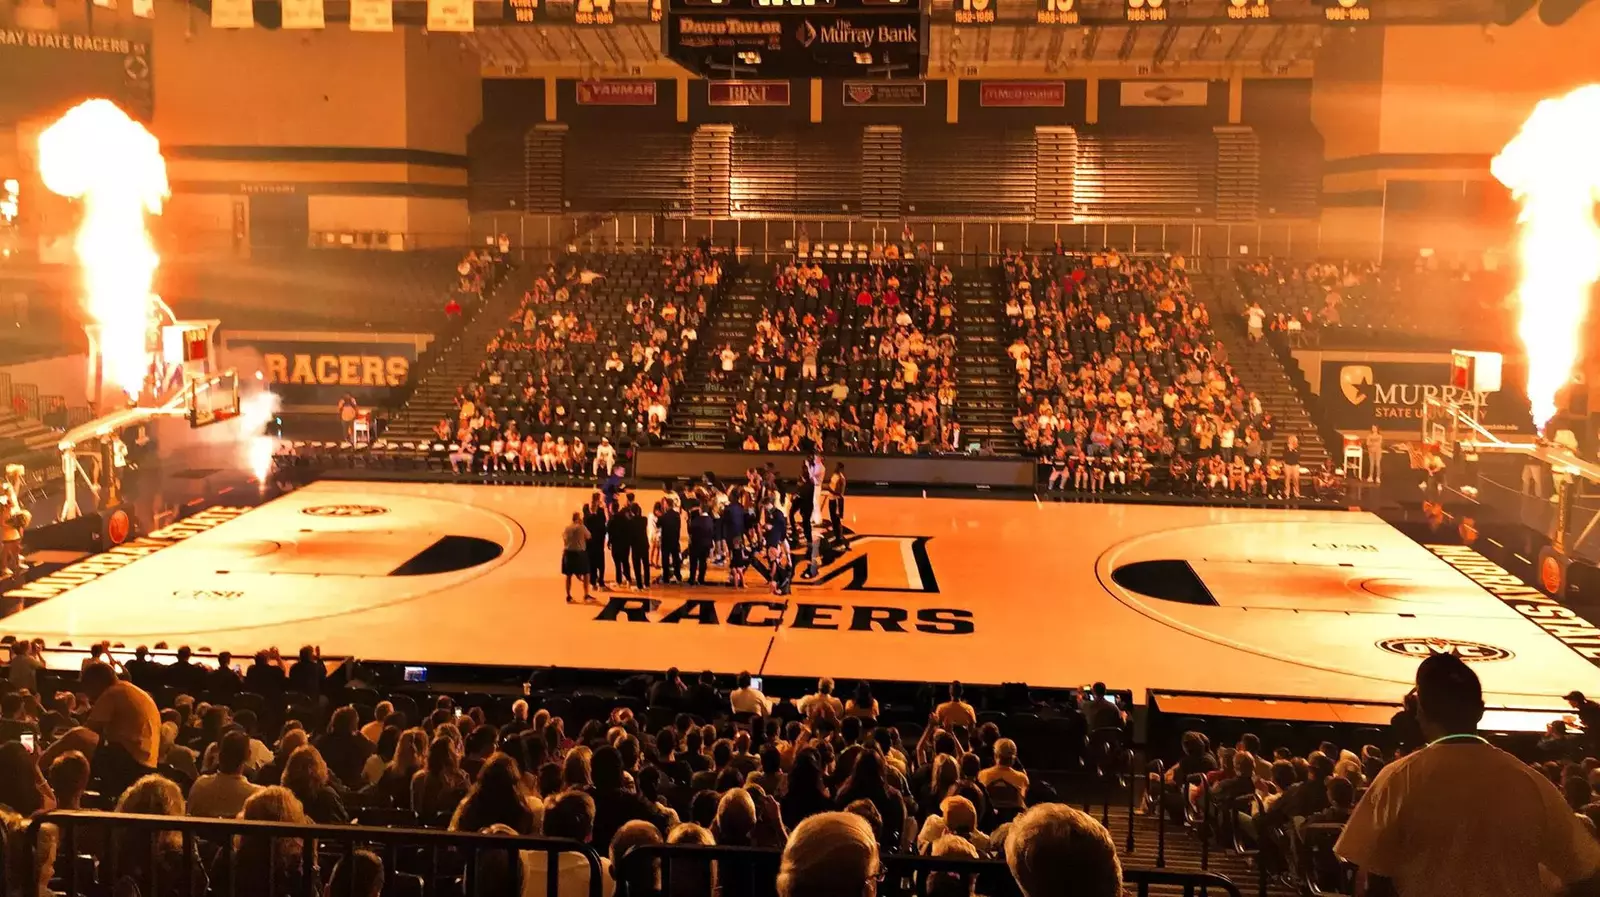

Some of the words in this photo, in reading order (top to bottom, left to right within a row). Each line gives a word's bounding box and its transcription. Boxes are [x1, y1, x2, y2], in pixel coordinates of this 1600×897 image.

[820, 25, 875, 48] Murray
[878, 25, 917, 43] Bank
[836, 19, 851, 31] The
[27, 32, 71, 49] STATE
[73, 33, 129, 53] RACERS
[728, 86, 769, 101] BB&T
[264, 352, 409, 387] RACERS
[1373, 383, 1490, 407] MURRAY
[1375, 407, 1412, 419] STATE
[1424, 543, 1560, 605] MURRAY
[592, 596, 976, 635] RACERS
